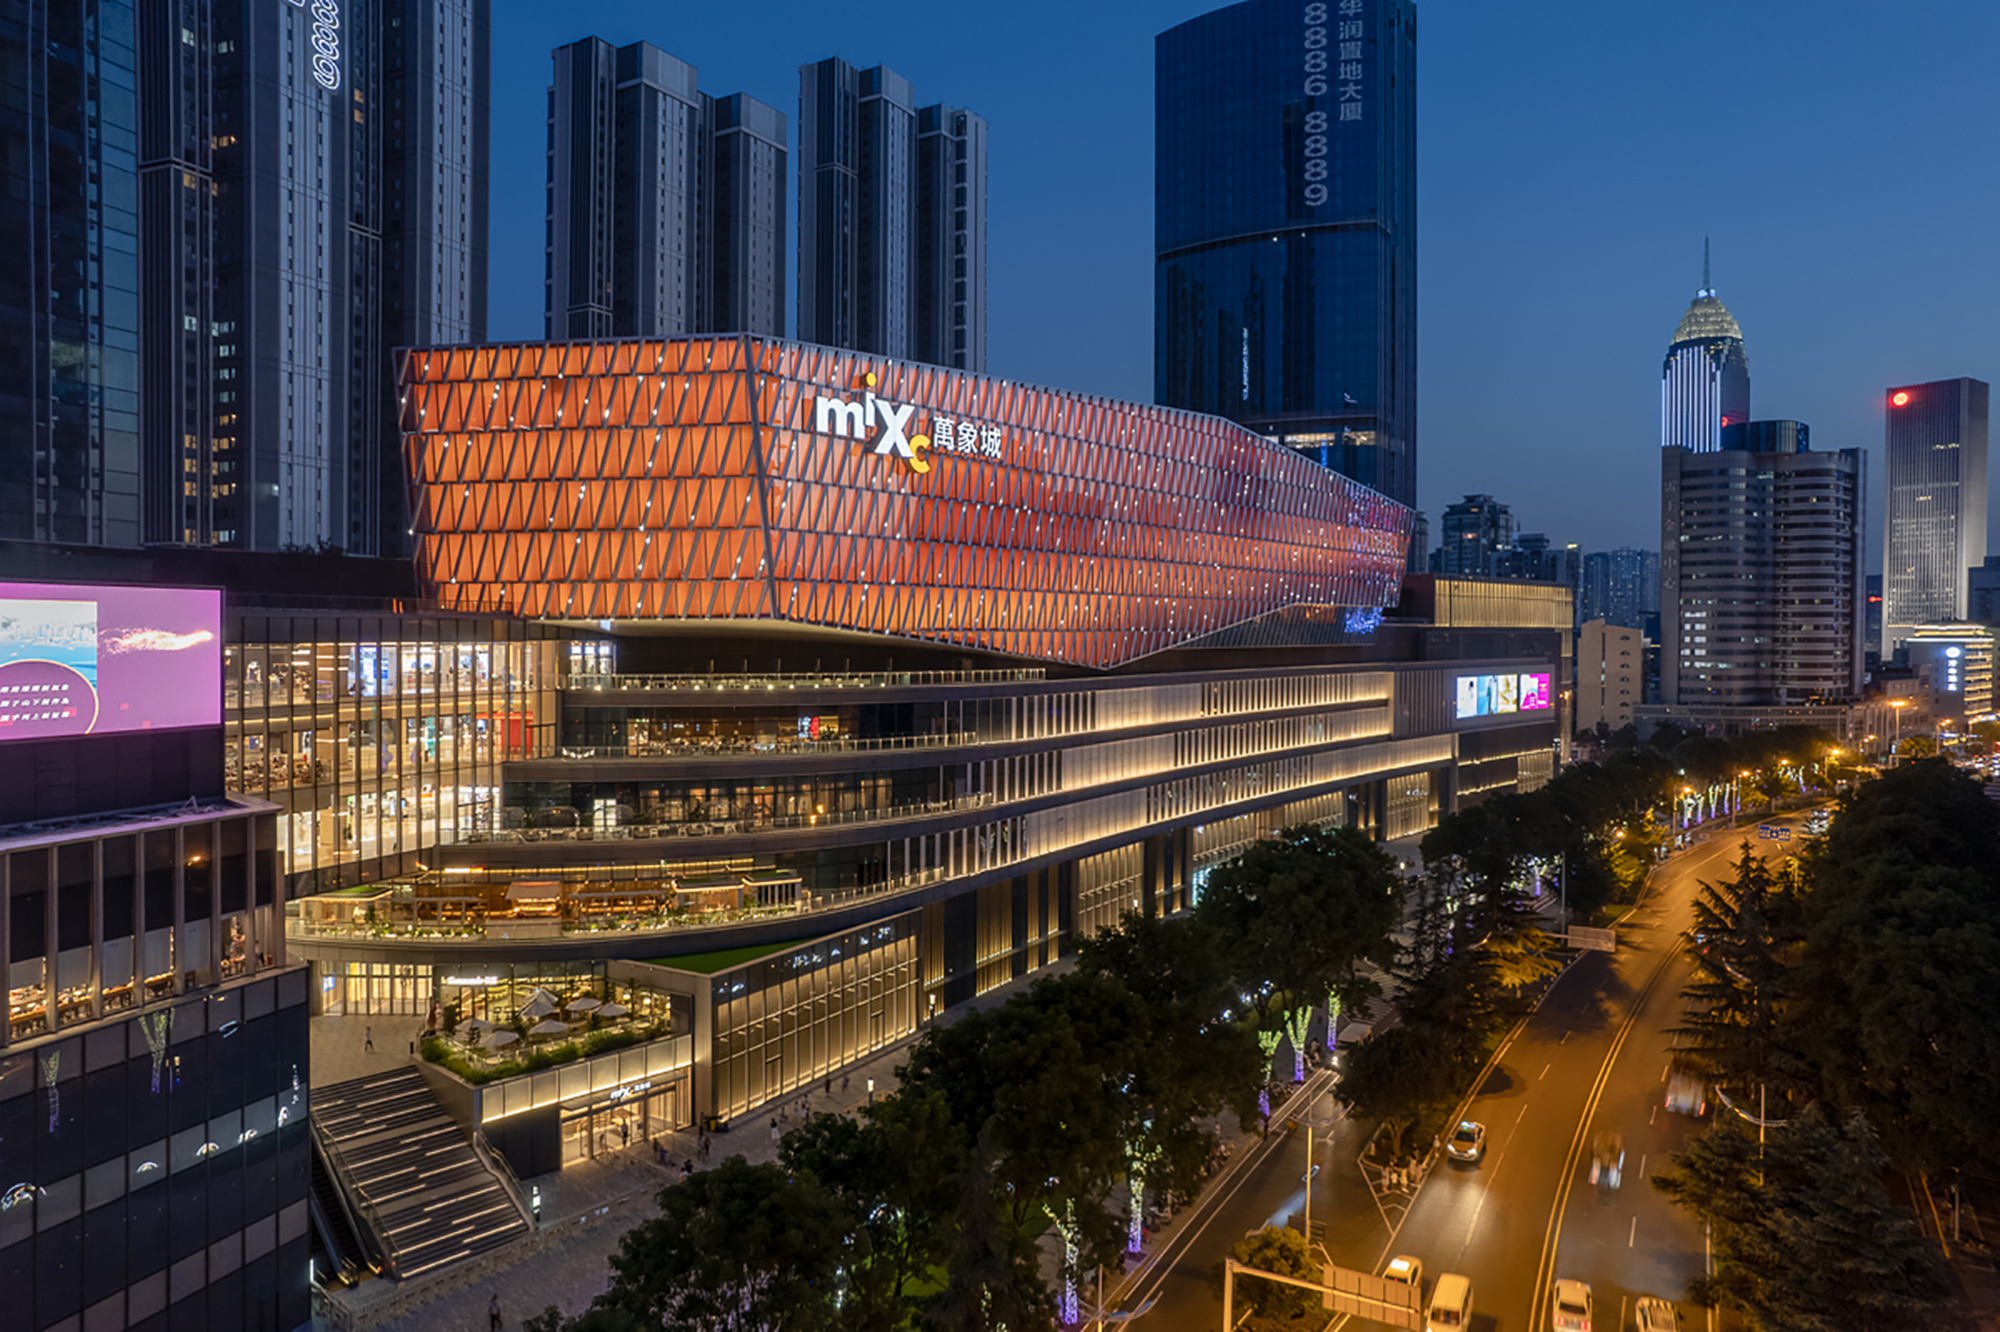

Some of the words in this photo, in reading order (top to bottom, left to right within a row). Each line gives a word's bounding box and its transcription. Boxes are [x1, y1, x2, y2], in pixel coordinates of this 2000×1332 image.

[1304, 2, 1328, 97] 8886
[1339, 0, 1364, 122] 华润置地大厦
[1304, 111, 1328, 207] 8889
[933, 415, 1002, 460] 萬象城
